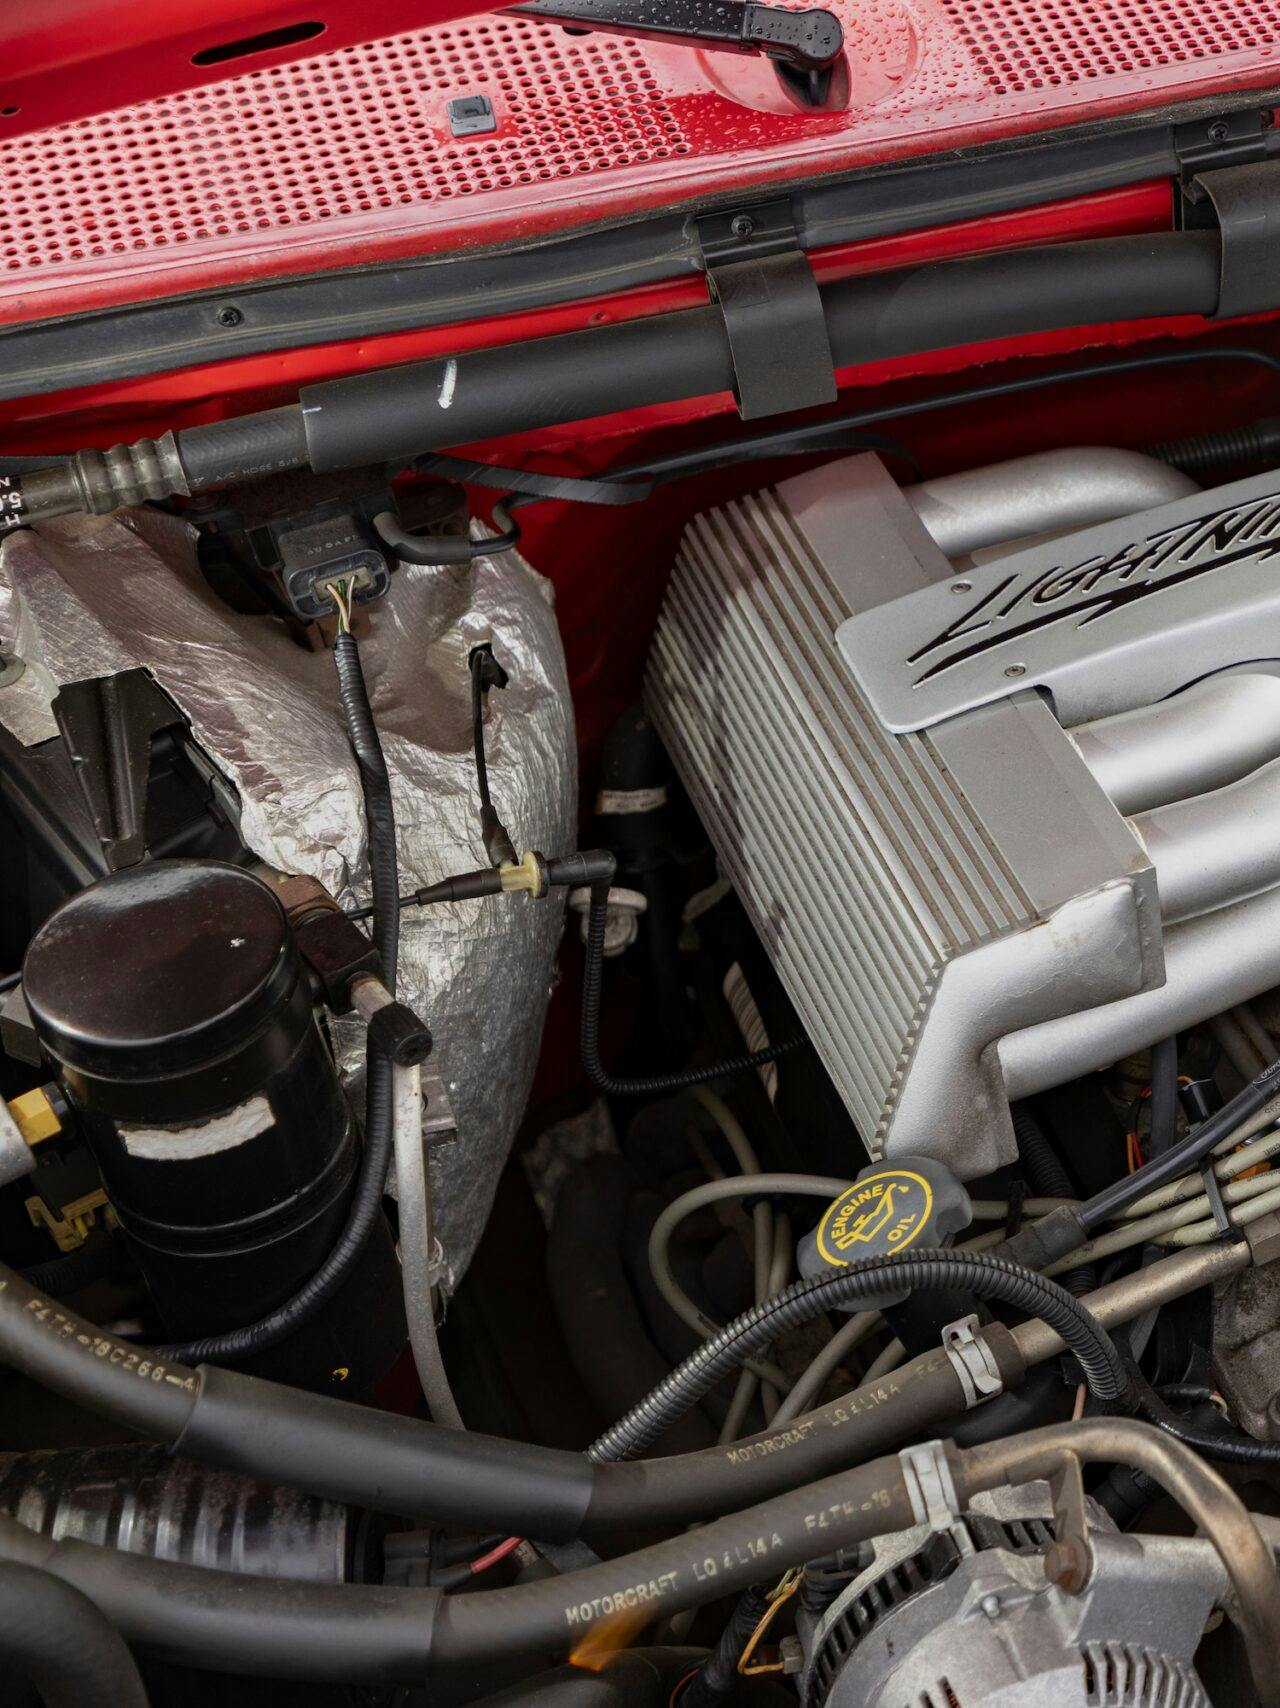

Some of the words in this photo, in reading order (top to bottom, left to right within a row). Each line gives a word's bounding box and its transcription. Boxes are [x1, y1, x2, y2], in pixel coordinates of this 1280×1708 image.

[831, 1183, 884, 1239] ENGINE
[888, 1213, 916, 1242] OIL
[726, 1421, 816, 1465] MOTORCRAFT
[565, 1571, 679, 1626] MOTORCRAFT
